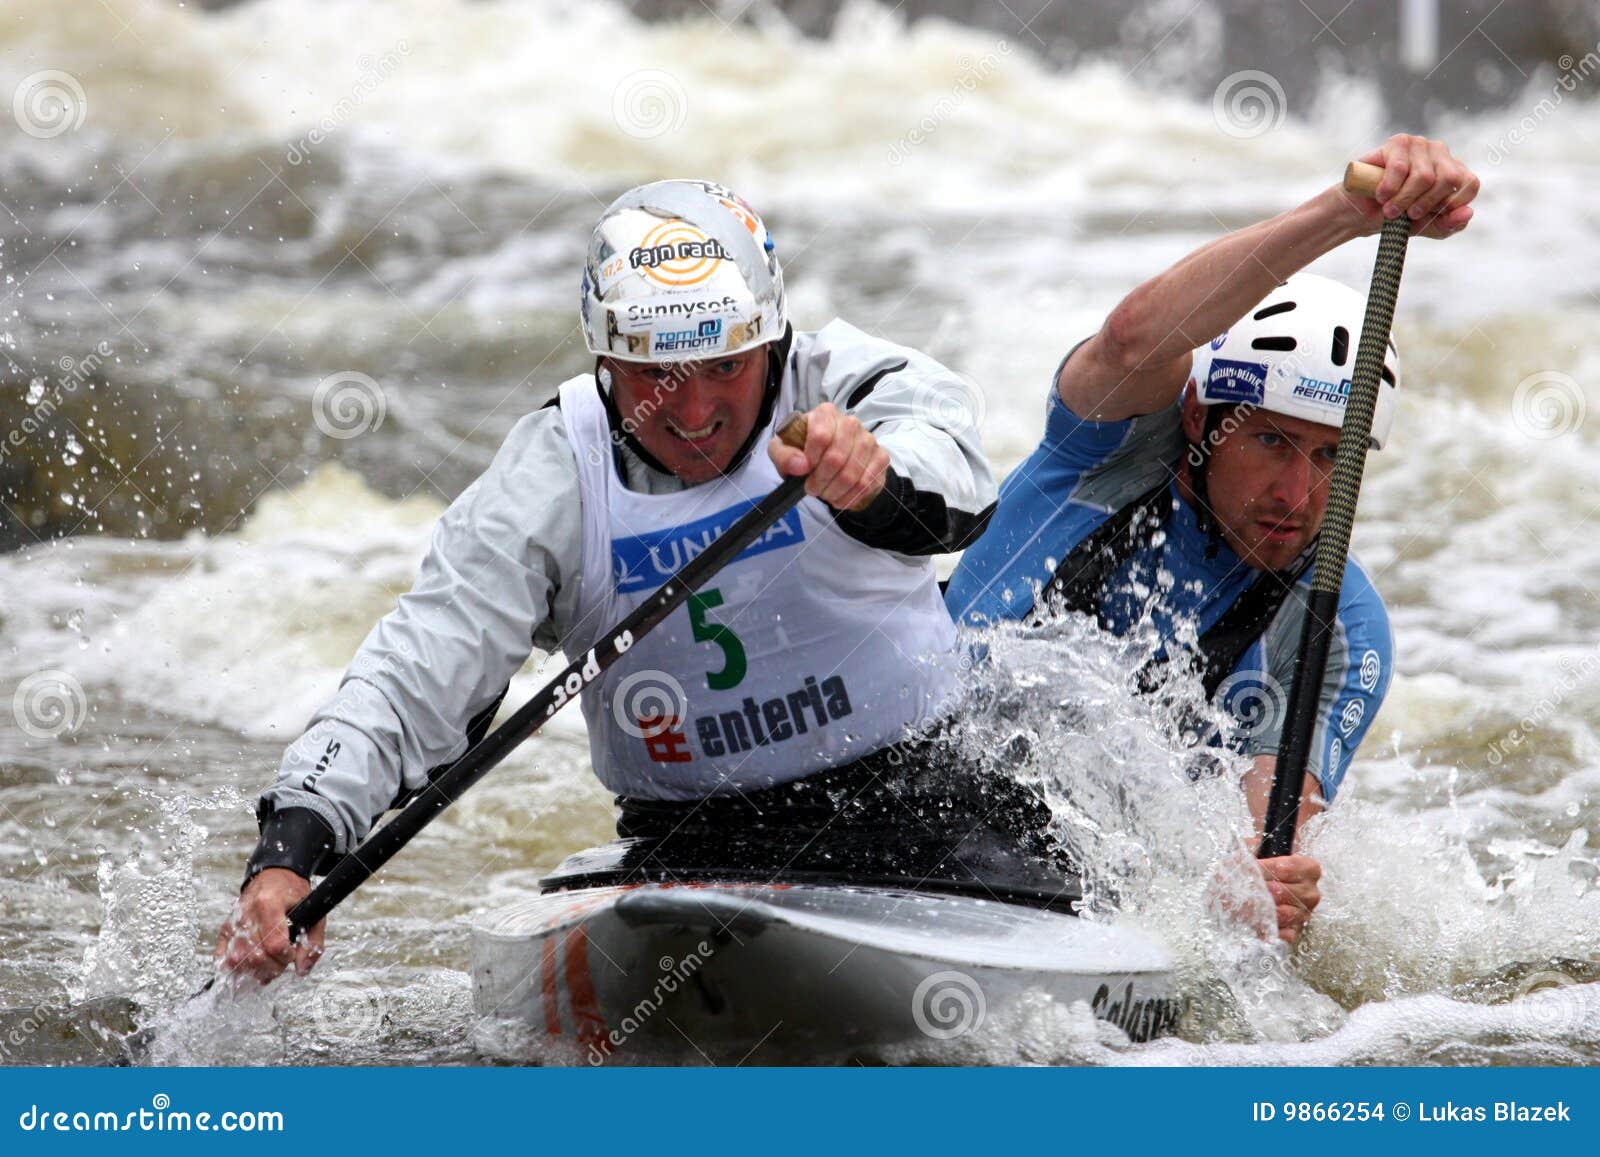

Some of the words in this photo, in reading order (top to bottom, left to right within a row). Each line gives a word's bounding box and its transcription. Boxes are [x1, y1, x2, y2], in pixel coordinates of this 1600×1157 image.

[629, 244, 675, 269] fajn
[628, 296, 738, 321] Sunnysoft
[654, 335, 721, 351] REMONT
[1293, 386, 1348, 406] REMON
[650, 514, 794, 575] UNA
[687, 588, 747, 691] 5
